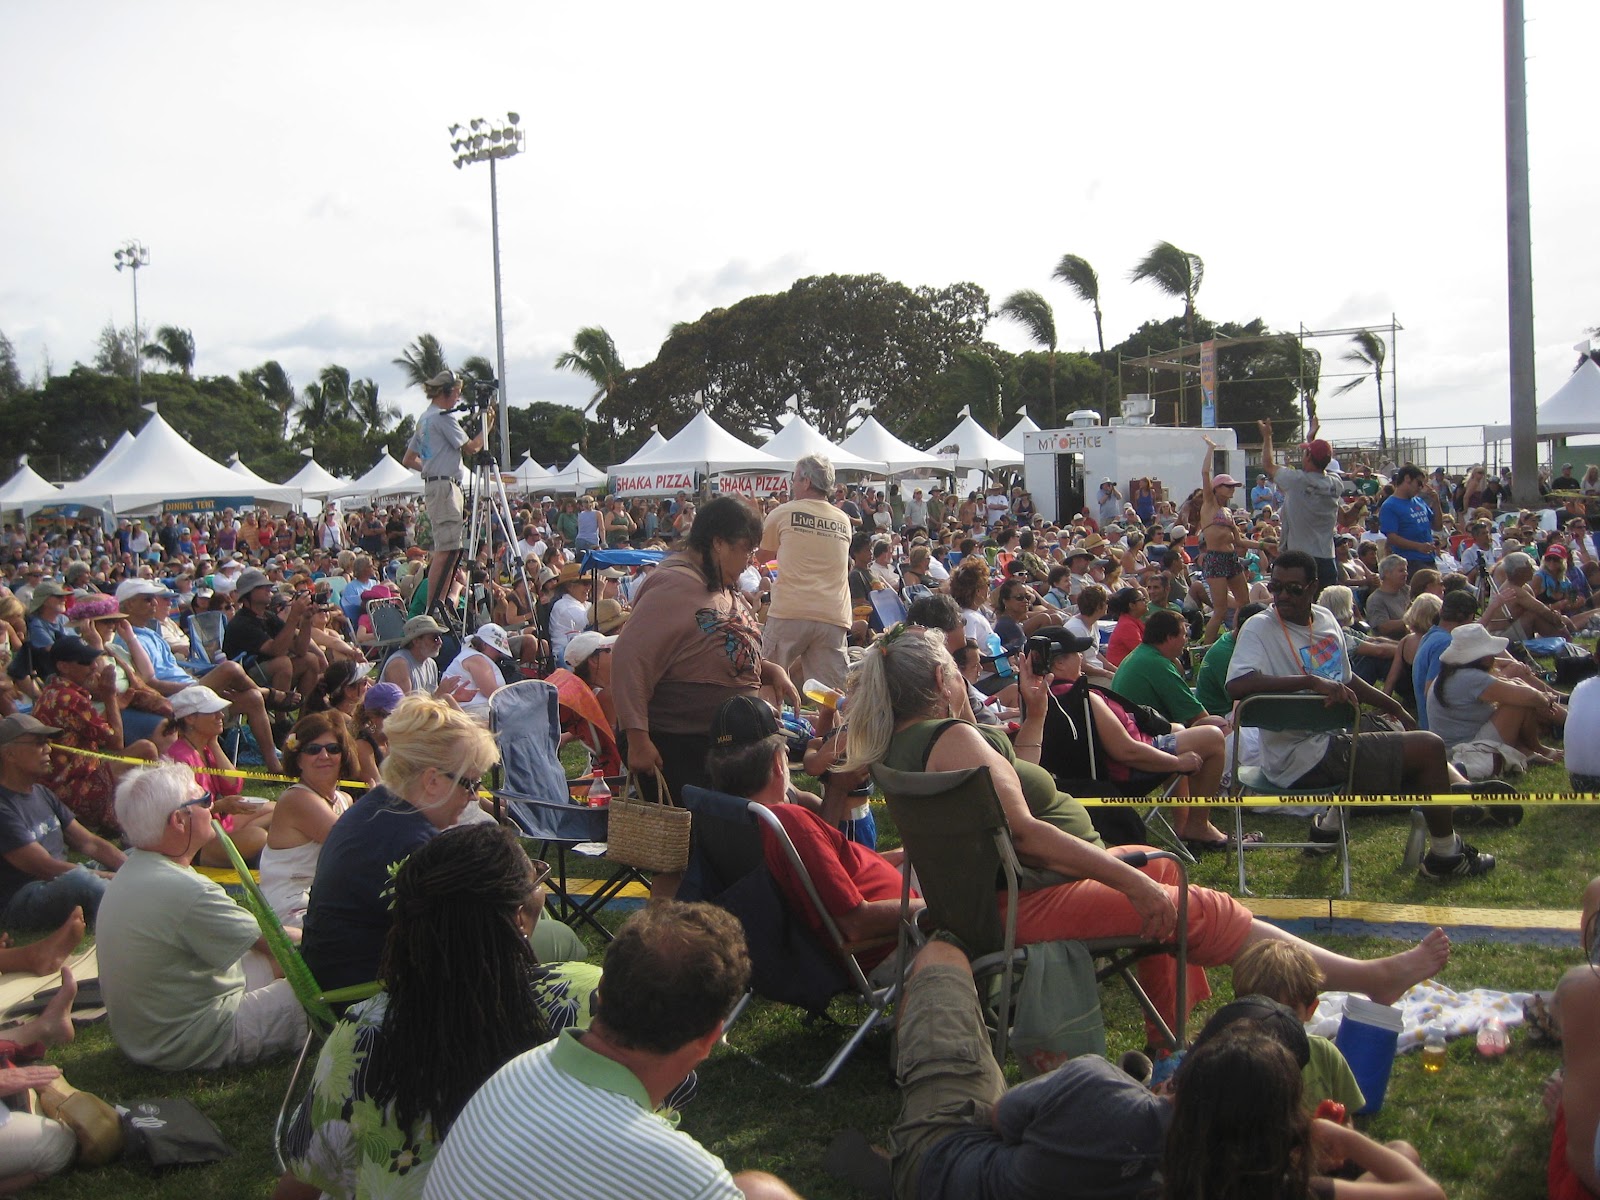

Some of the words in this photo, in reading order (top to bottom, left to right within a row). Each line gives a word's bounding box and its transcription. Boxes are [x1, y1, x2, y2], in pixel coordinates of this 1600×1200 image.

[616, 475, 652, 491] SHAKA
[655, 473, 692, 489] PIZZA
[719, 477, 751, 492] SHAKA
[755, 476, 788, 491] PIZZA
[165, 501, 194, 511] DINING
[196, 500, 215, 509] TENT
[792, 513, 814, 527] Live
[816, 519, 847, 534] ALOHA
